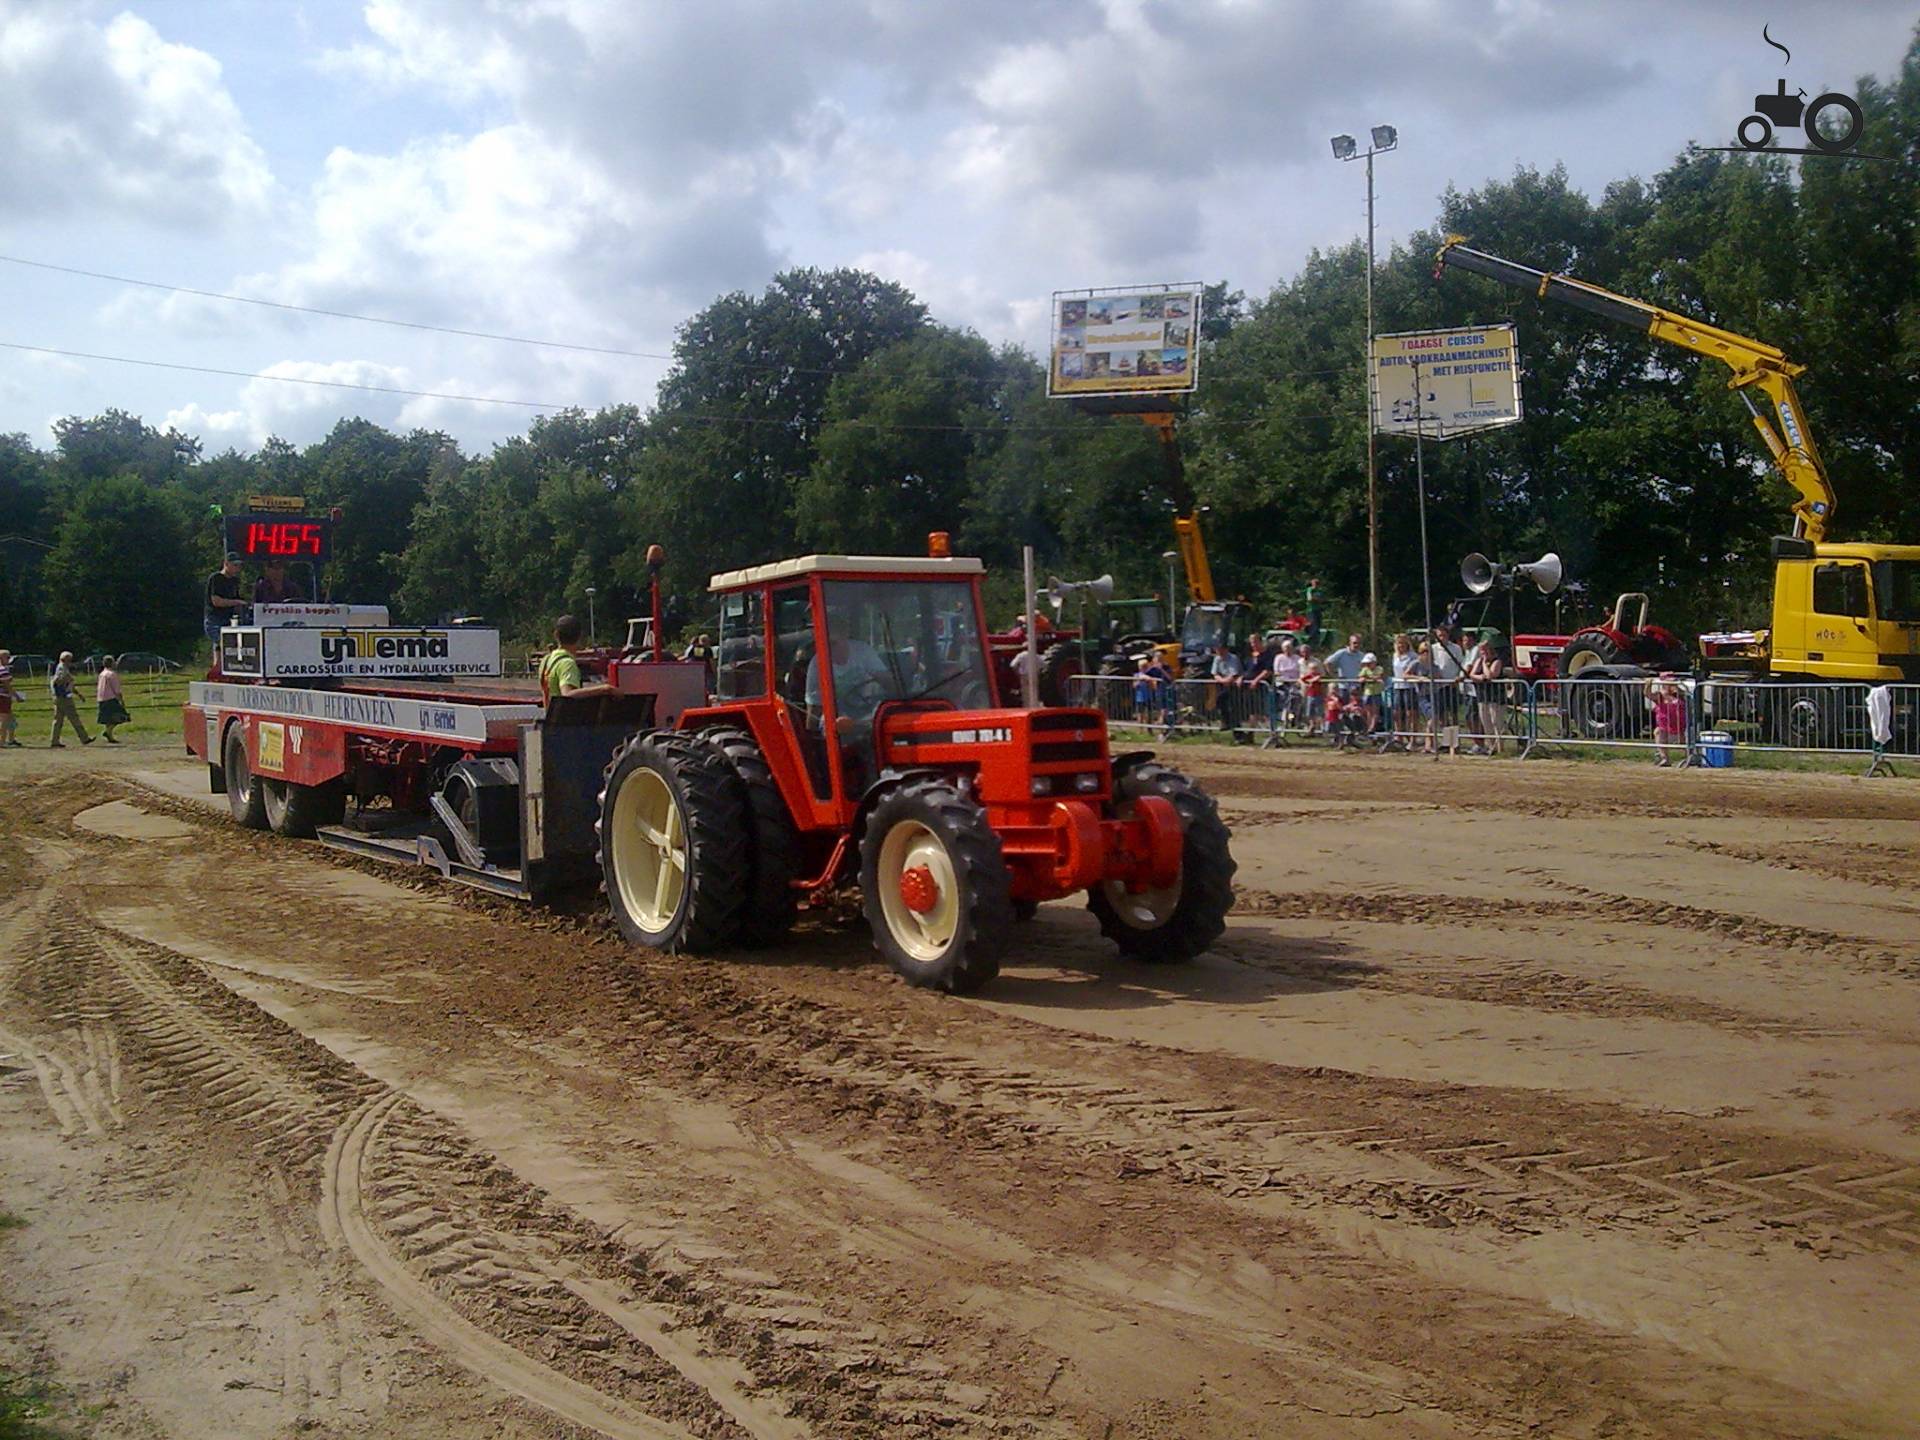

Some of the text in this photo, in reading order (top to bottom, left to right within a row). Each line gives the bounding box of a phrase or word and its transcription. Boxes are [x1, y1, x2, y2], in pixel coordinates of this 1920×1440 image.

[1447, 334, 1485, 346] CURSUS
[1433, 365, 1450, 376] MET
[276, 663, 491, 675] CARROSSERIE EN HYDRAULIEKSERVICE
[324, 699, 396, 725] HEERENVEEN
